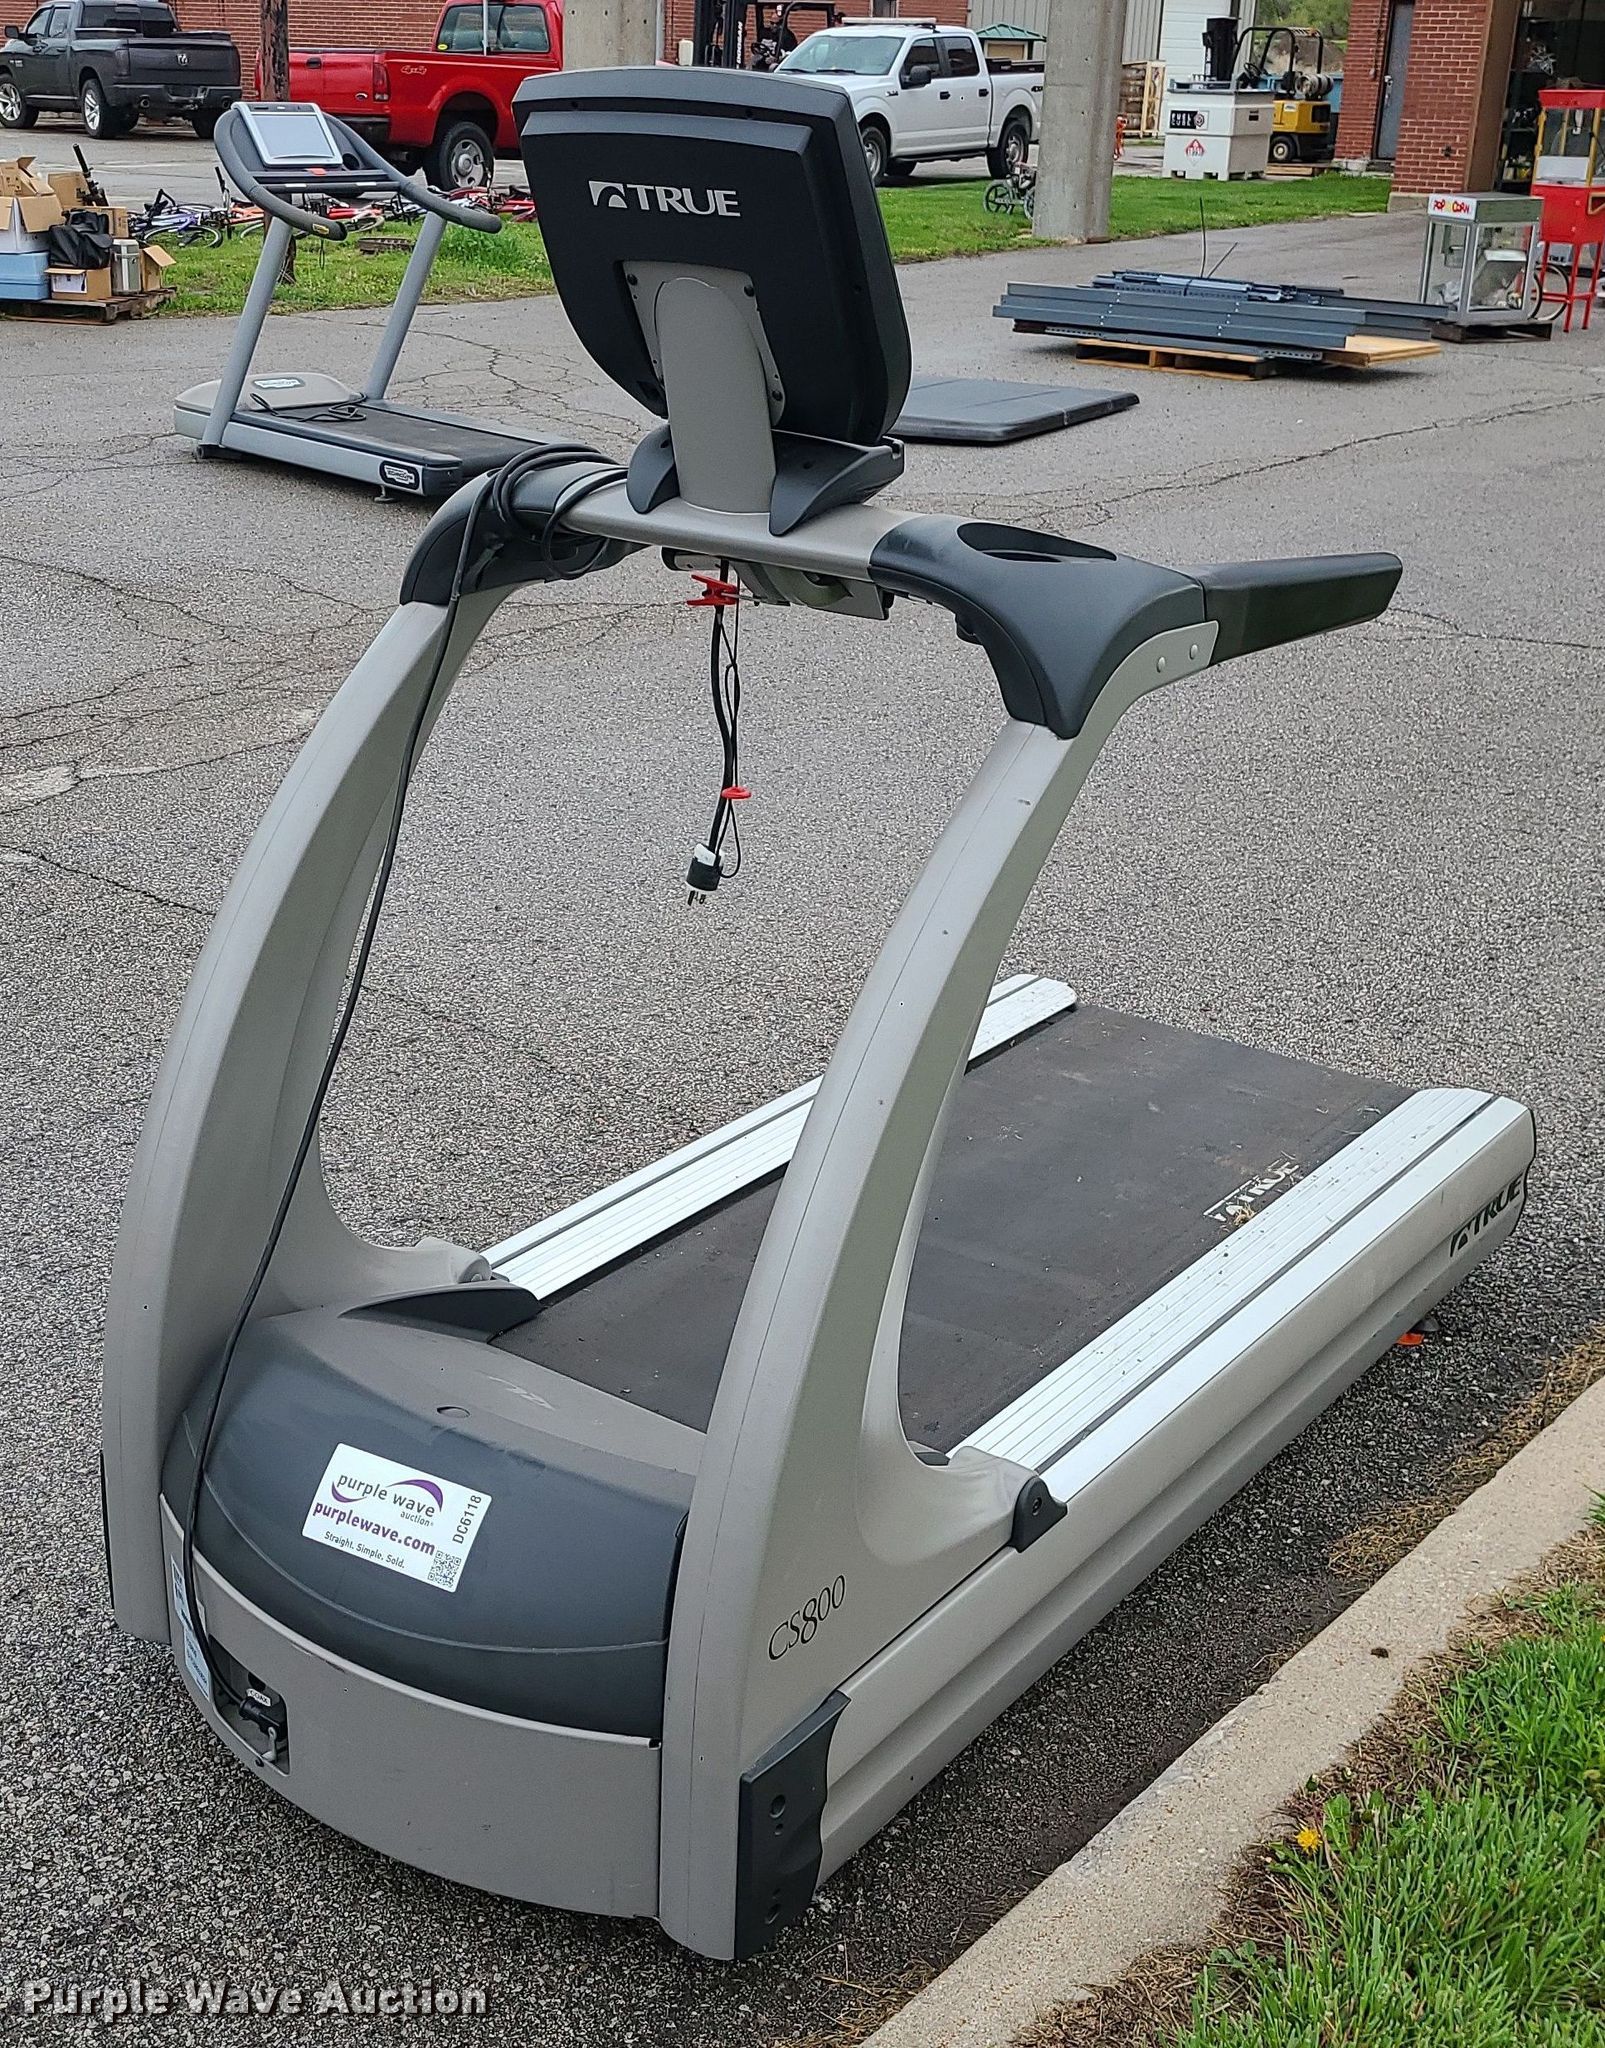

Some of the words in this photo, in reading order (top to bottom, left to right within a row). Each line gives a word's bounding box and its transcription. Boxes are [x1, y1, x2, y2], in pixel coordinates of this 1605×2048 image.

[626, 183, 741, 217] TRUE
[1469, 1172, 1524, 1235] TRUE
[336, 1474, 388, 1500] purple
[393, 1492, 435, 1518] wave
[452, 1495, 482, 1544] DC6118
[313, 1502, 435, 1556] purplewave.com
[324, 1531, 354, 1550] Straight.
[356, 1543, 384, 1561] Simple.
[386, 1554, 405, 1568] Sold.
[769, 1575, 845, 1660] CS800
